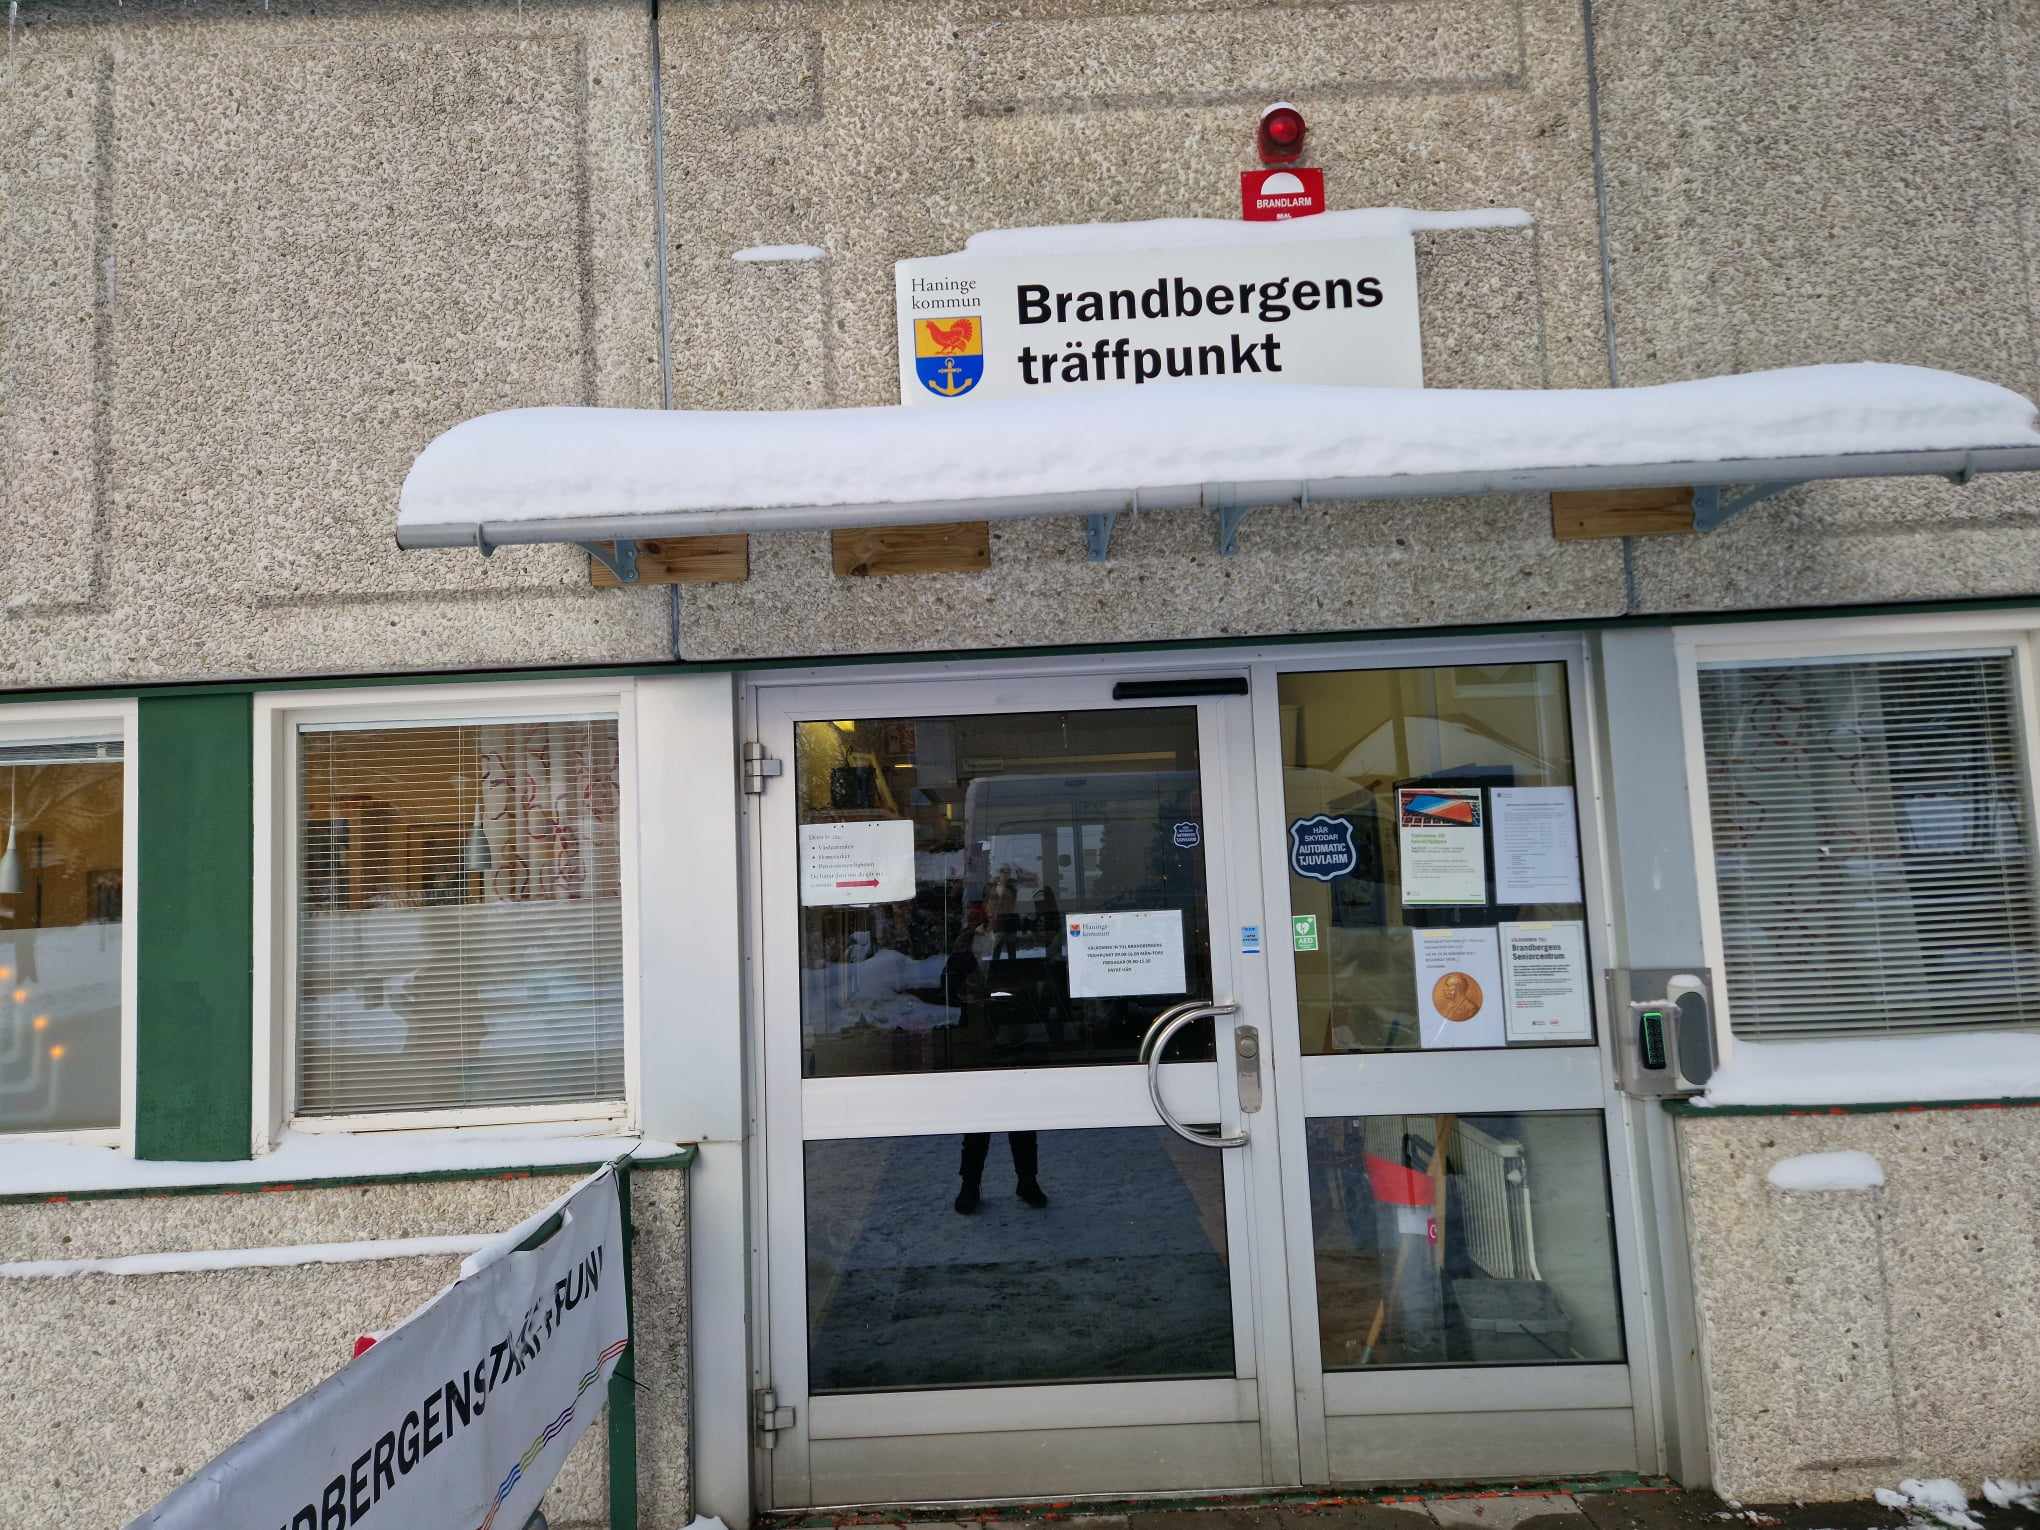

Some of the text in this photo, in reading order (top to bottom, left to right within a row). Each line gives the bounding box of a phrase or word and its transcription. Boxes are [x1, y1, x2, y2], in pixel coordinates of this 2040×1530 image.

[1256, 197, 1312, 209] BRANDLARM
[911, 277, 977, 294] Haninge
[911, 295, 981, 310] kommun
[1017, 276, 1384, 325] Brandbergens
[1017, 333, 1283, 384] träffpunkt
[1312, 826, 1329, 834] HÄR
[1304, 834, 1339, 842] SKYDDAR
[1299, 843, 1346, 854] AUTOMATIC
[1298, 854, 1348, 866] TJUVLARM
[1298, 937, 1314, 945] AED
